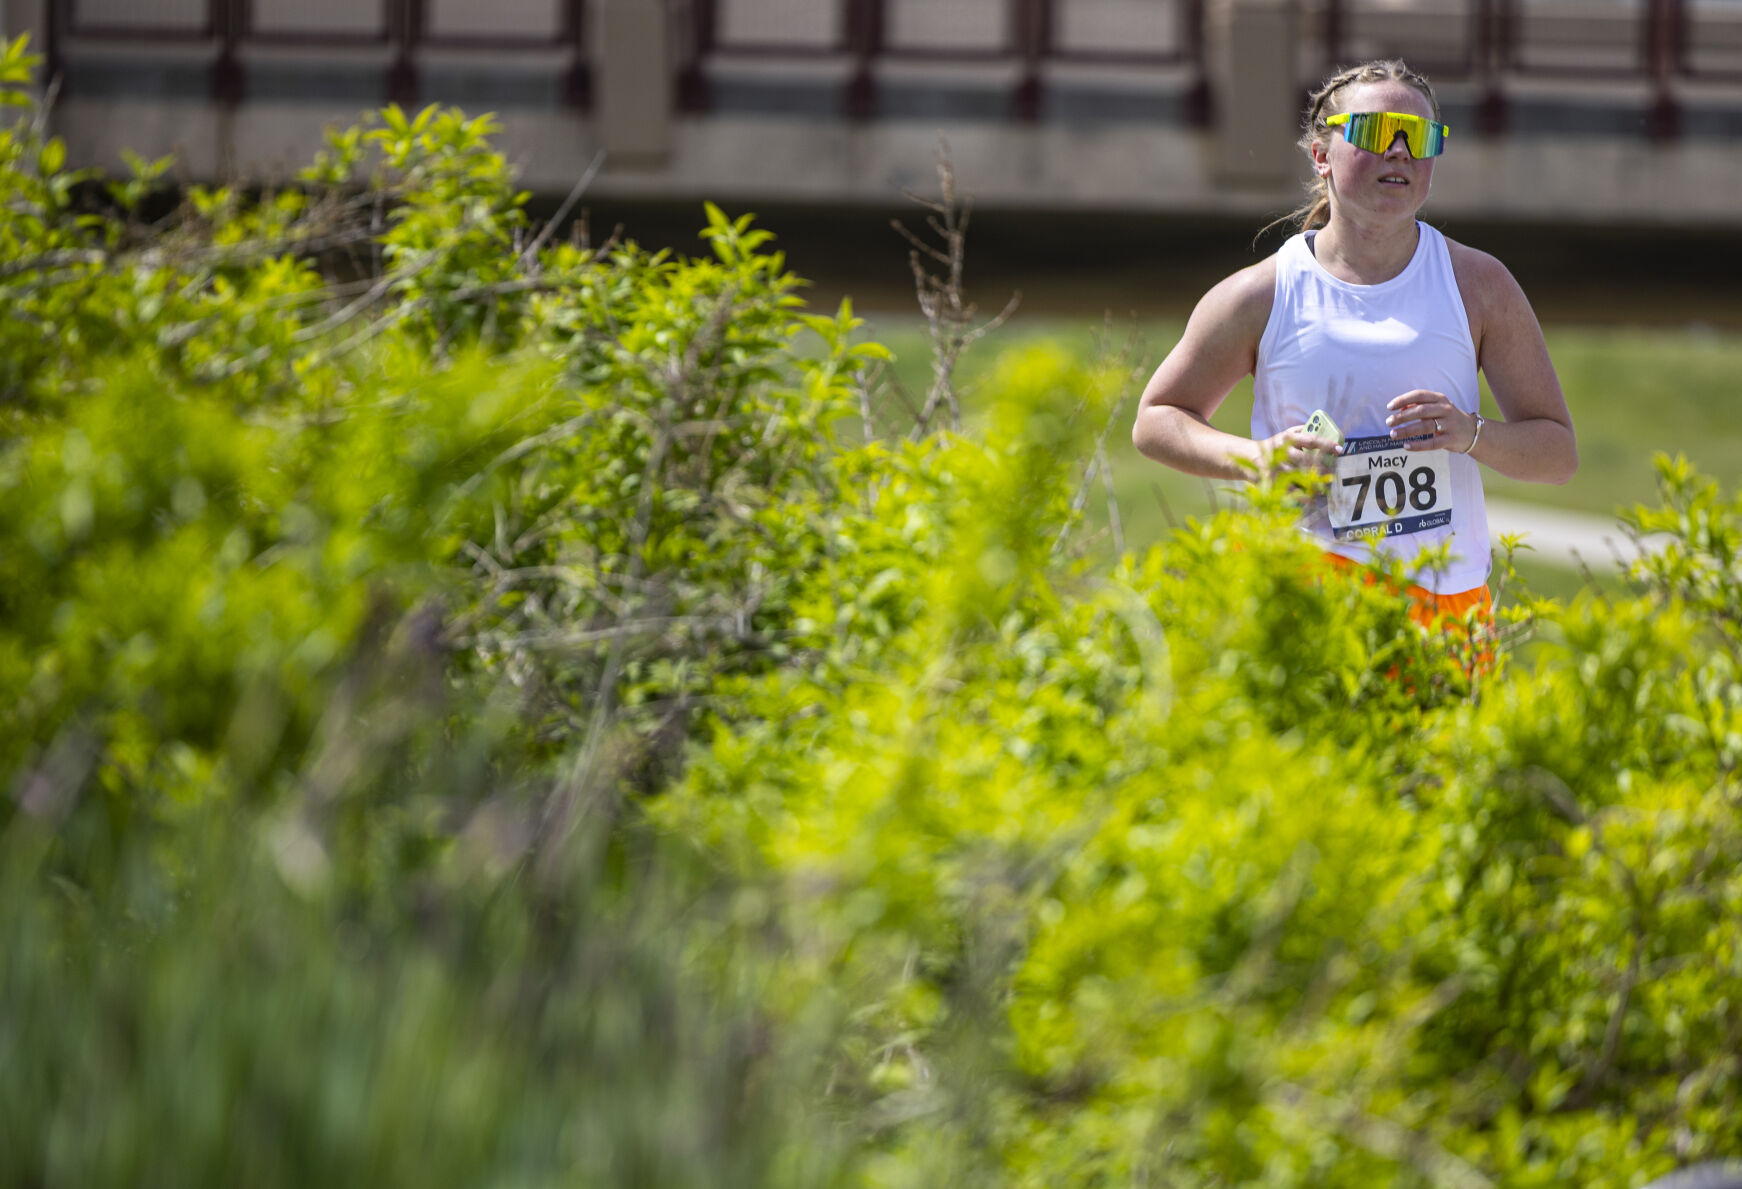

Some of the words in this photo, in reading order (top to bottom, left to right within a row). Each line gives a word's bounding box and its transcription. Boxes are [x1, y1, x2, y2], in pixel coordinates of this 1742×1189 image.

[1368, 455, 1408, 470] Macy
[1342, 466, 1437, 522] 708
[1394, 522, 1403, 534] D
